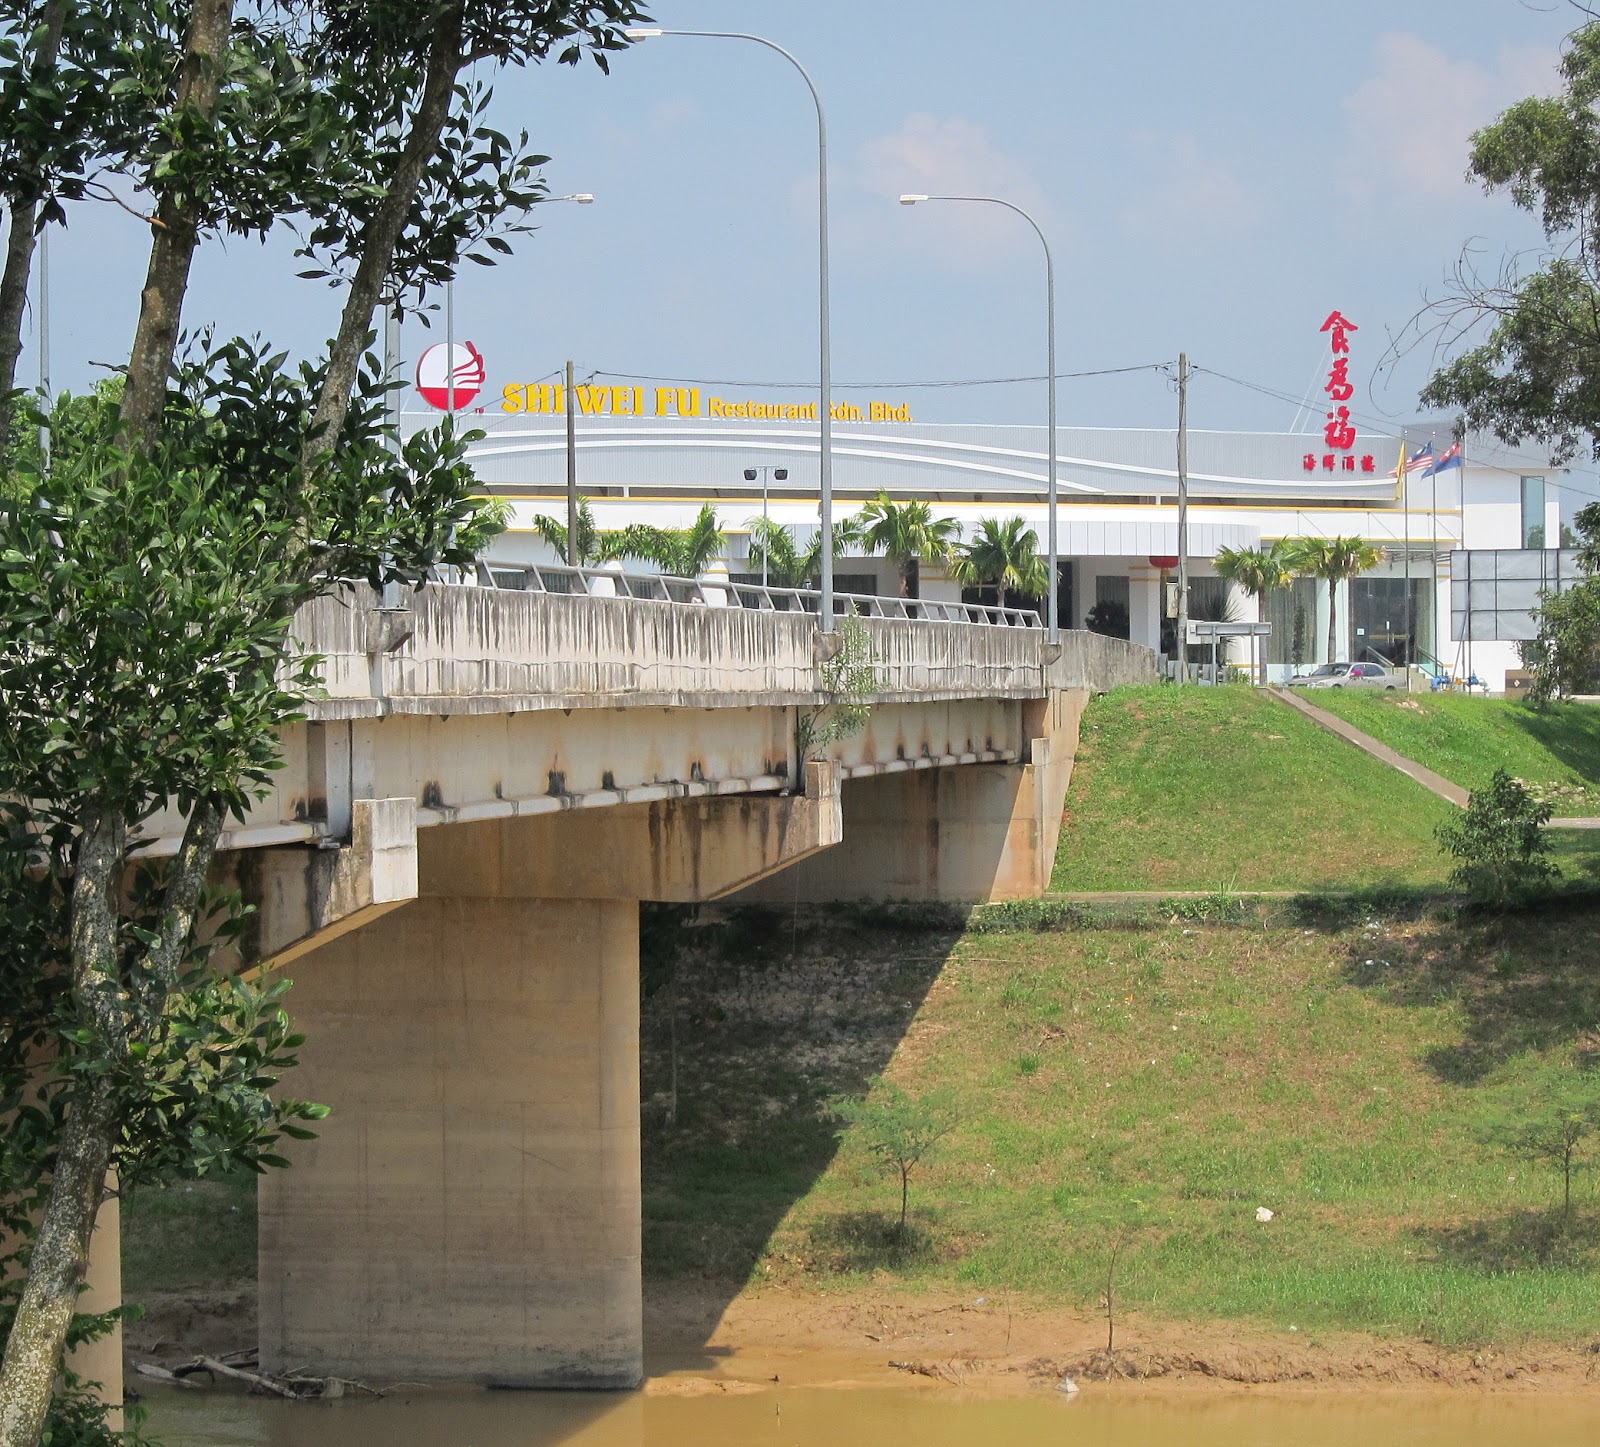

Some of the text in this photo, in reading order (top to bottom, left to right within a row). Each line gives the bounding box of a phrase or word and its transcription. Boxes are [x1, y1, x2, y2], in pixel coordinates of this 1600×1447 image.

[502, 383, 565, 413] SHI
[574, 384, 645, 416] WEI
[654, 387, 700, 417] FU
[709, 397, 818, 420] Restaurant
[869, 402, 914, 422] Bhd.
